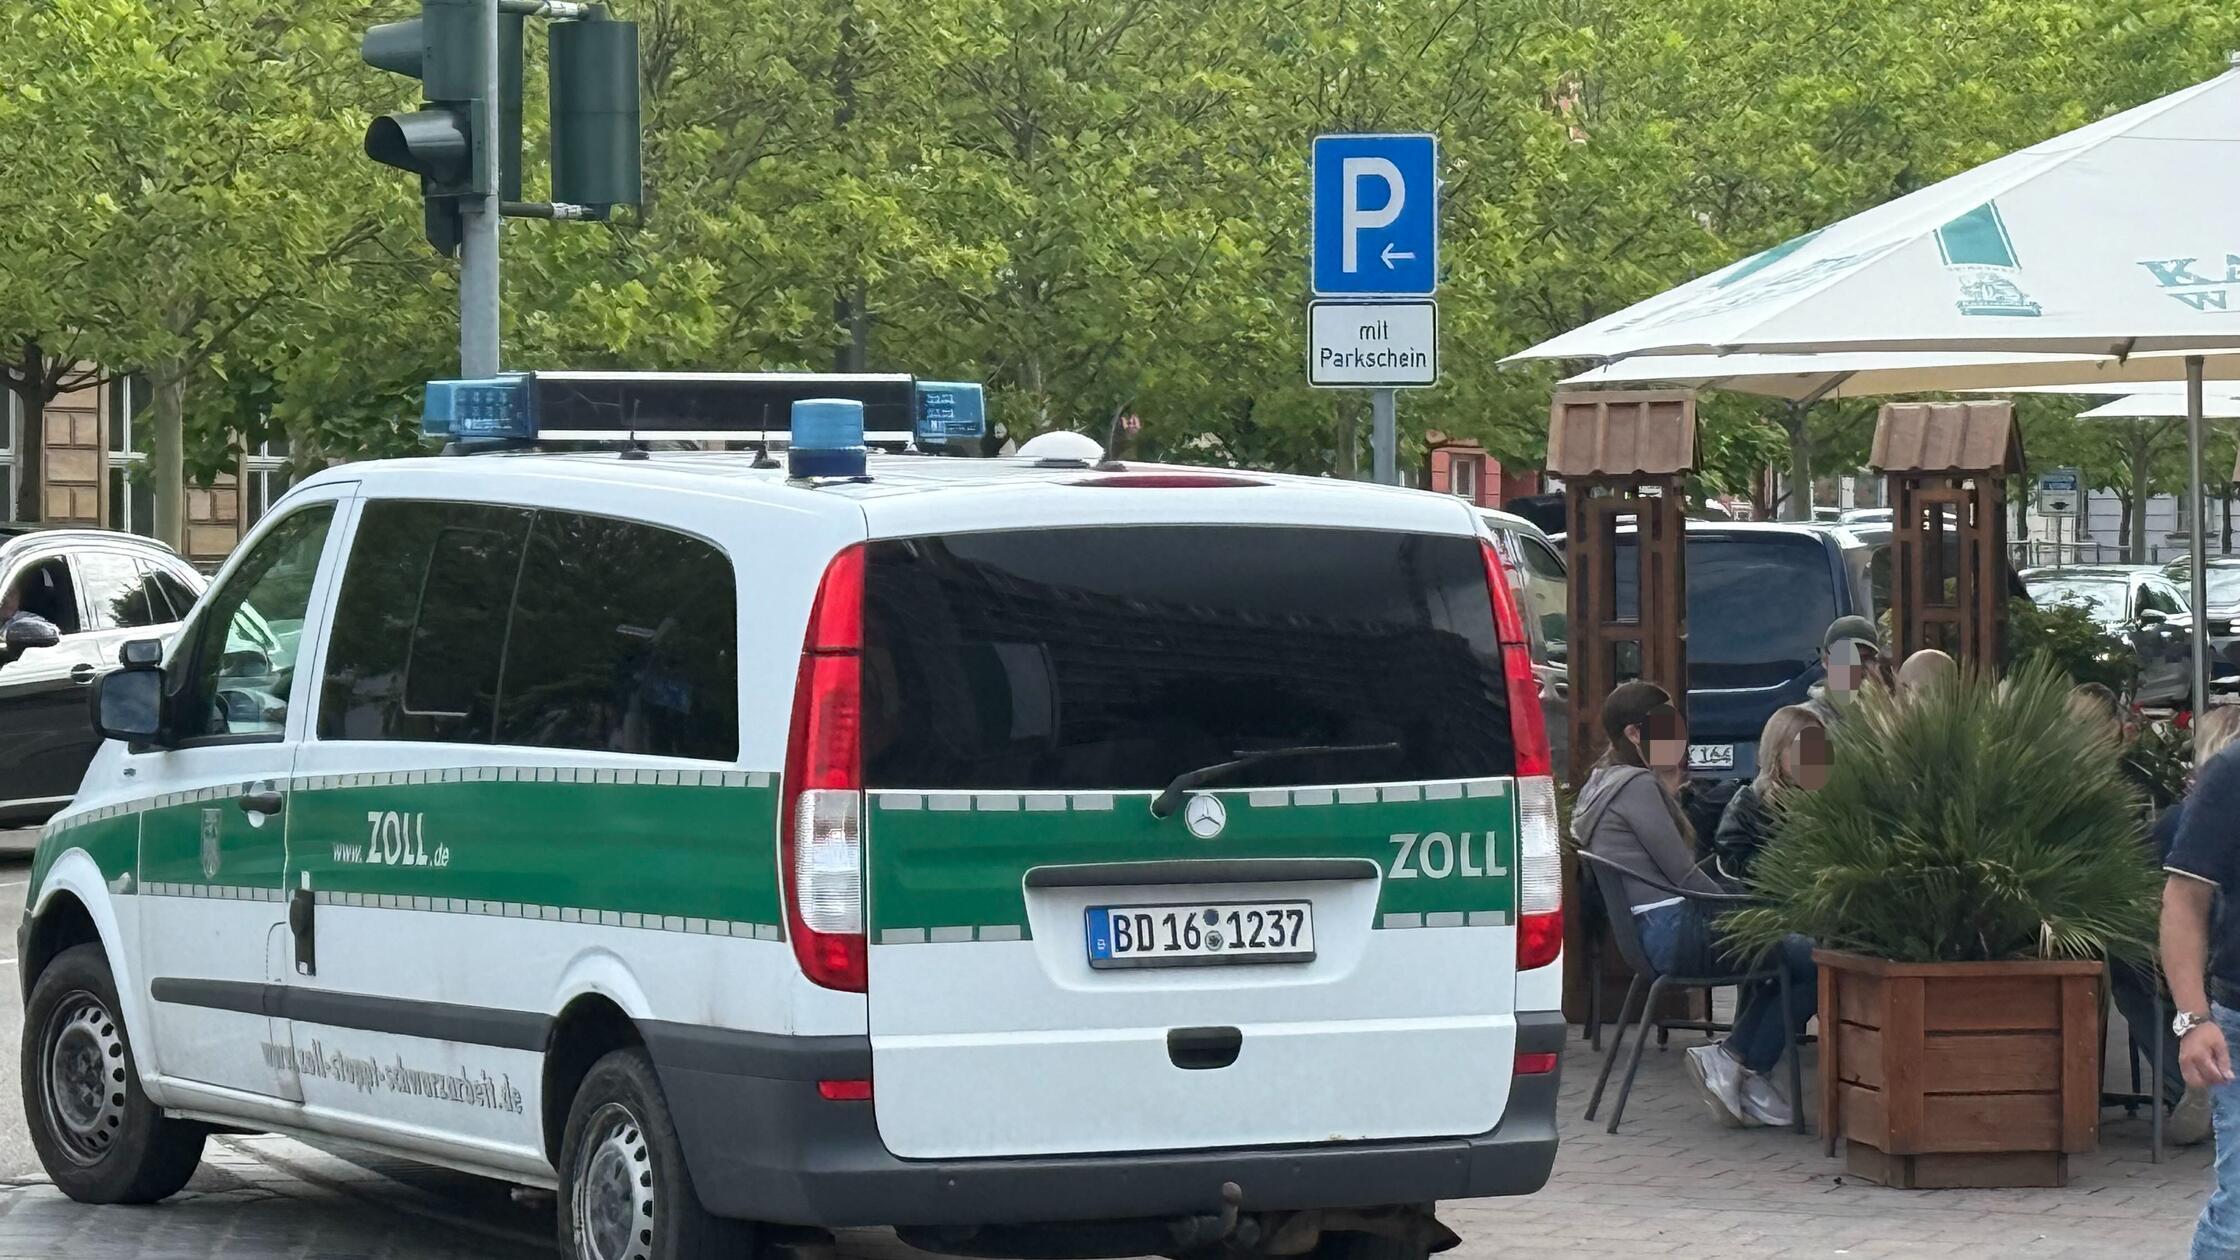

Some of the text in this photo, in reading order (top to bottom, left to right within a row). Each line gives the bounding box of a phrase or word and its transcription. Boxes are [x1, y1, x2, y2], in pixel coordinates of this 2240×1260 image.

[1342, 157, 1406, 273] P
[1359, 319, 1388, 340] mit
[1320, 346, 1427, 368] Parkschein
[1387, 830, 1508, 879] ZOLL
[1226, 908, 1304, 949] 1237
